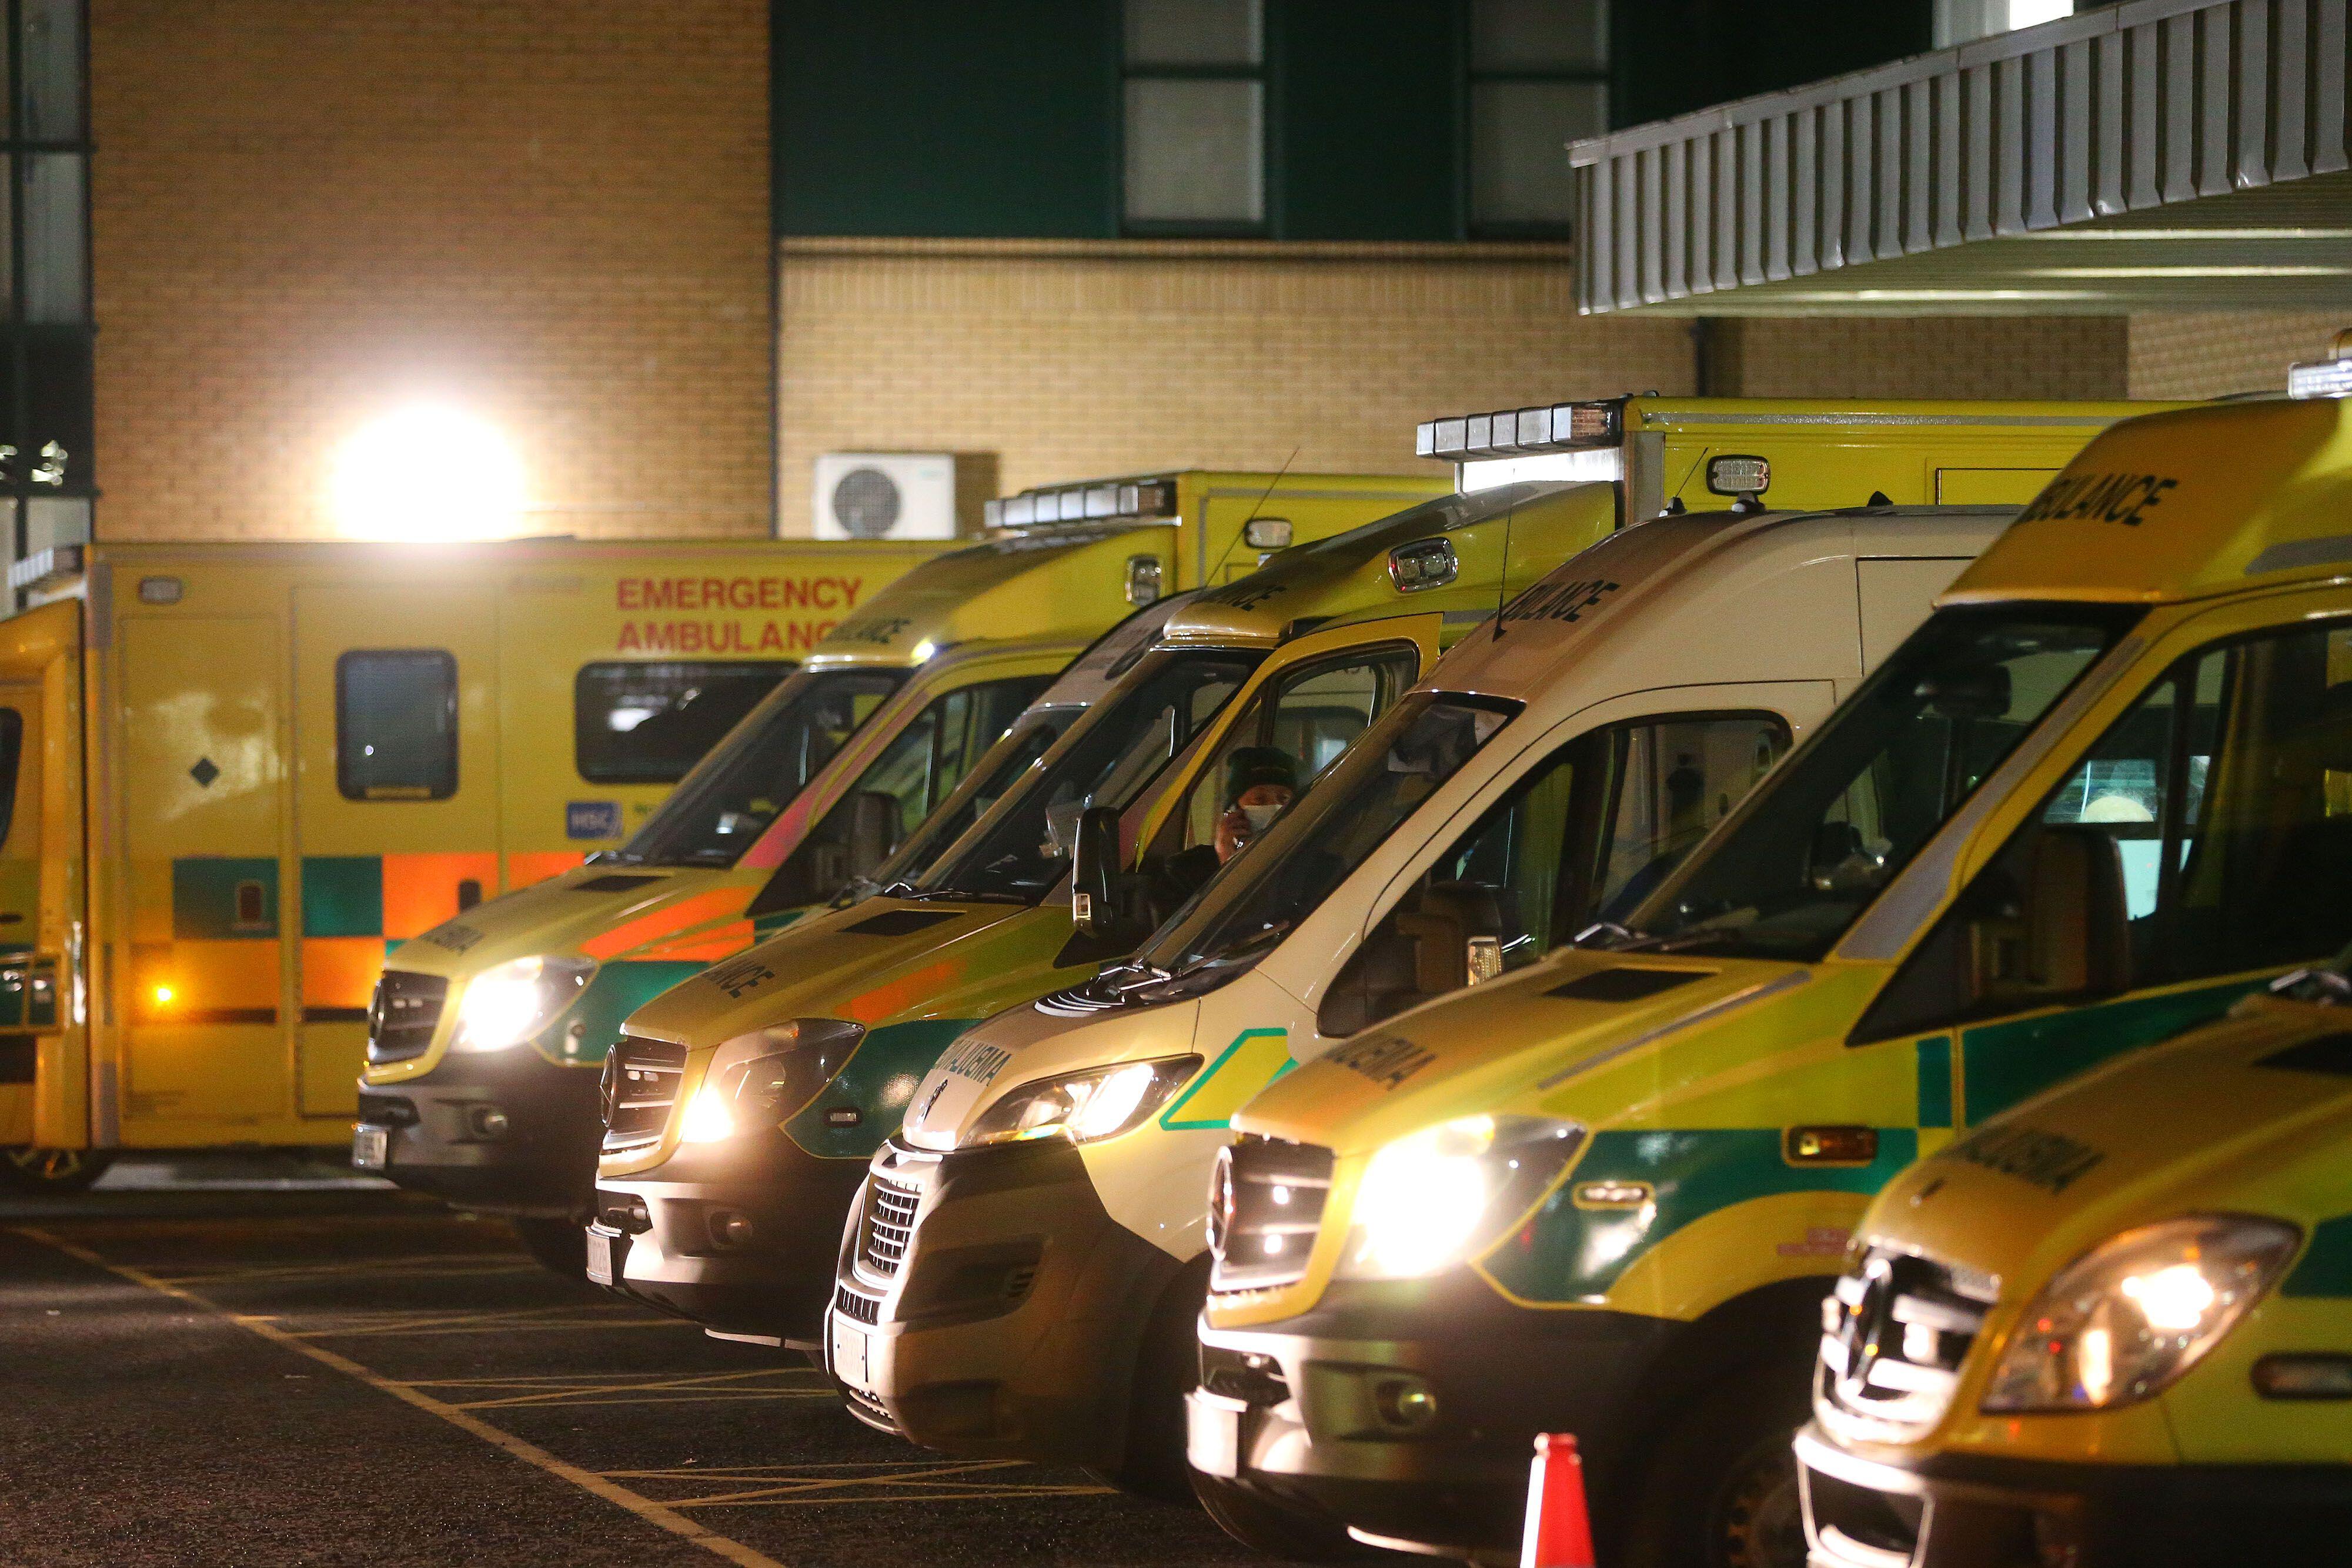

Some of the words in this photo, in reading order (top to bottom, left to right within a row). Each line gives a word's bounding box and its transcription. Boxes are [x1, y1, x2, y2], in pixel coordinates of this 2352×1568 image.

[2018, 473, 2177, 526] BULANCE
[616, 577, 863, 610] EMERGENCY
[1500, 579, 1621, 622] BULANCE
[616, 621, 839, 652] AMBULANC
